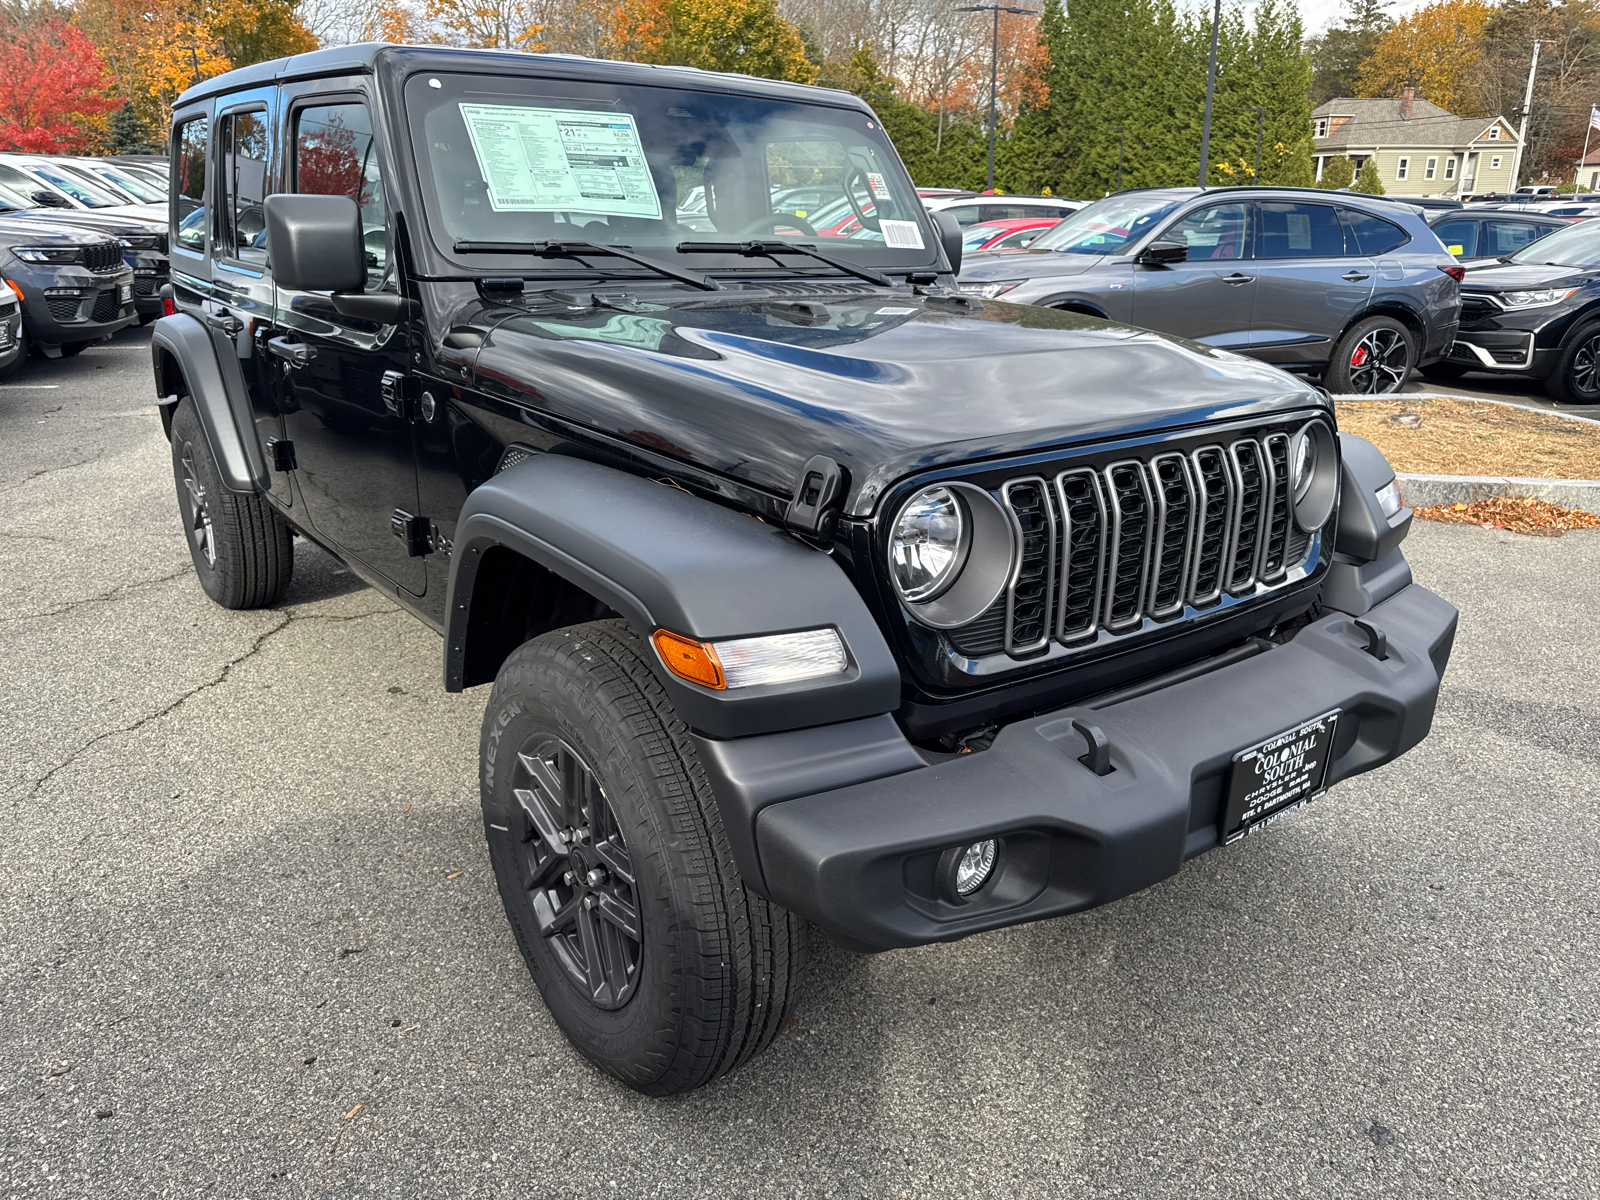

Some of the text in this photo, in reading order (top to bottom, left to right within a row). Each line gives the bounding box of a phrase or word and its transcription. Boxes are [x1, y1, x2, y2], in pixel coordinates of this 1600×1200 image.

[564, 128, 576, 137] 21
[426, 524, 454, 557] Jee
[485, 701, 522, 788] NEXEN
[1254, 735, 1318, 775] COLONIAL
[1262, 732, 1297, 753] COLONIAL
[1244, 760, 1317, 801] CHRYSLER Jeep
[1262, 753, 1305, 785] SOUTH
[1249, 773, 1309, 807] DODGE RAM
